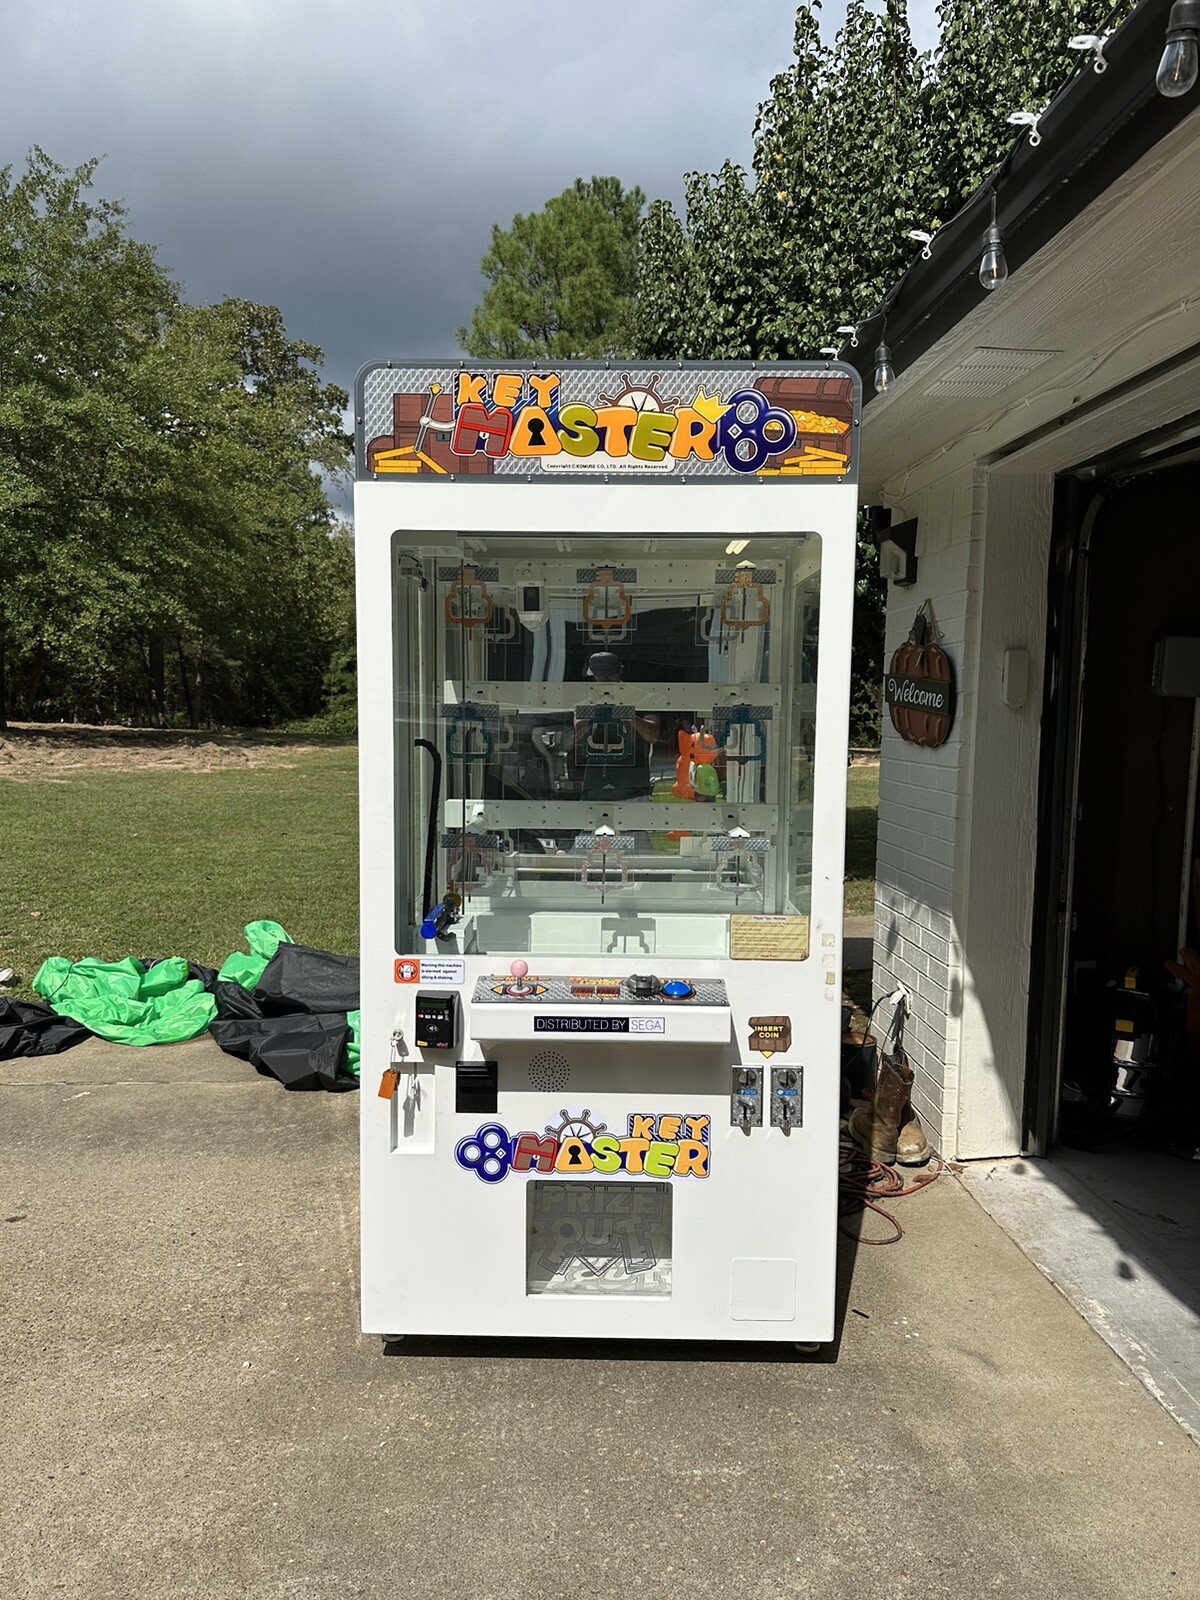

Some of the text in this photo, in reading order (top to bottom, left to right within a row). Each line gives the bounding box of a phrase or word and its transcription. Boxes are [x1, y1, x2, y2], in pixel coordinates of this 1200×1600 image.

[457, 373, 560, 407] KEY
[451, 402, 716, 461] MASTER
[888, 678, 944, 708] Welcome
[536, 1018, 662, 1031] DISTRIBUTED BY SEGA
[631, 1114, 710, 1140] KEY
[513, 1134, 709, 1178] MASTER
[541, 1184, 659, 1215] PRIZE
